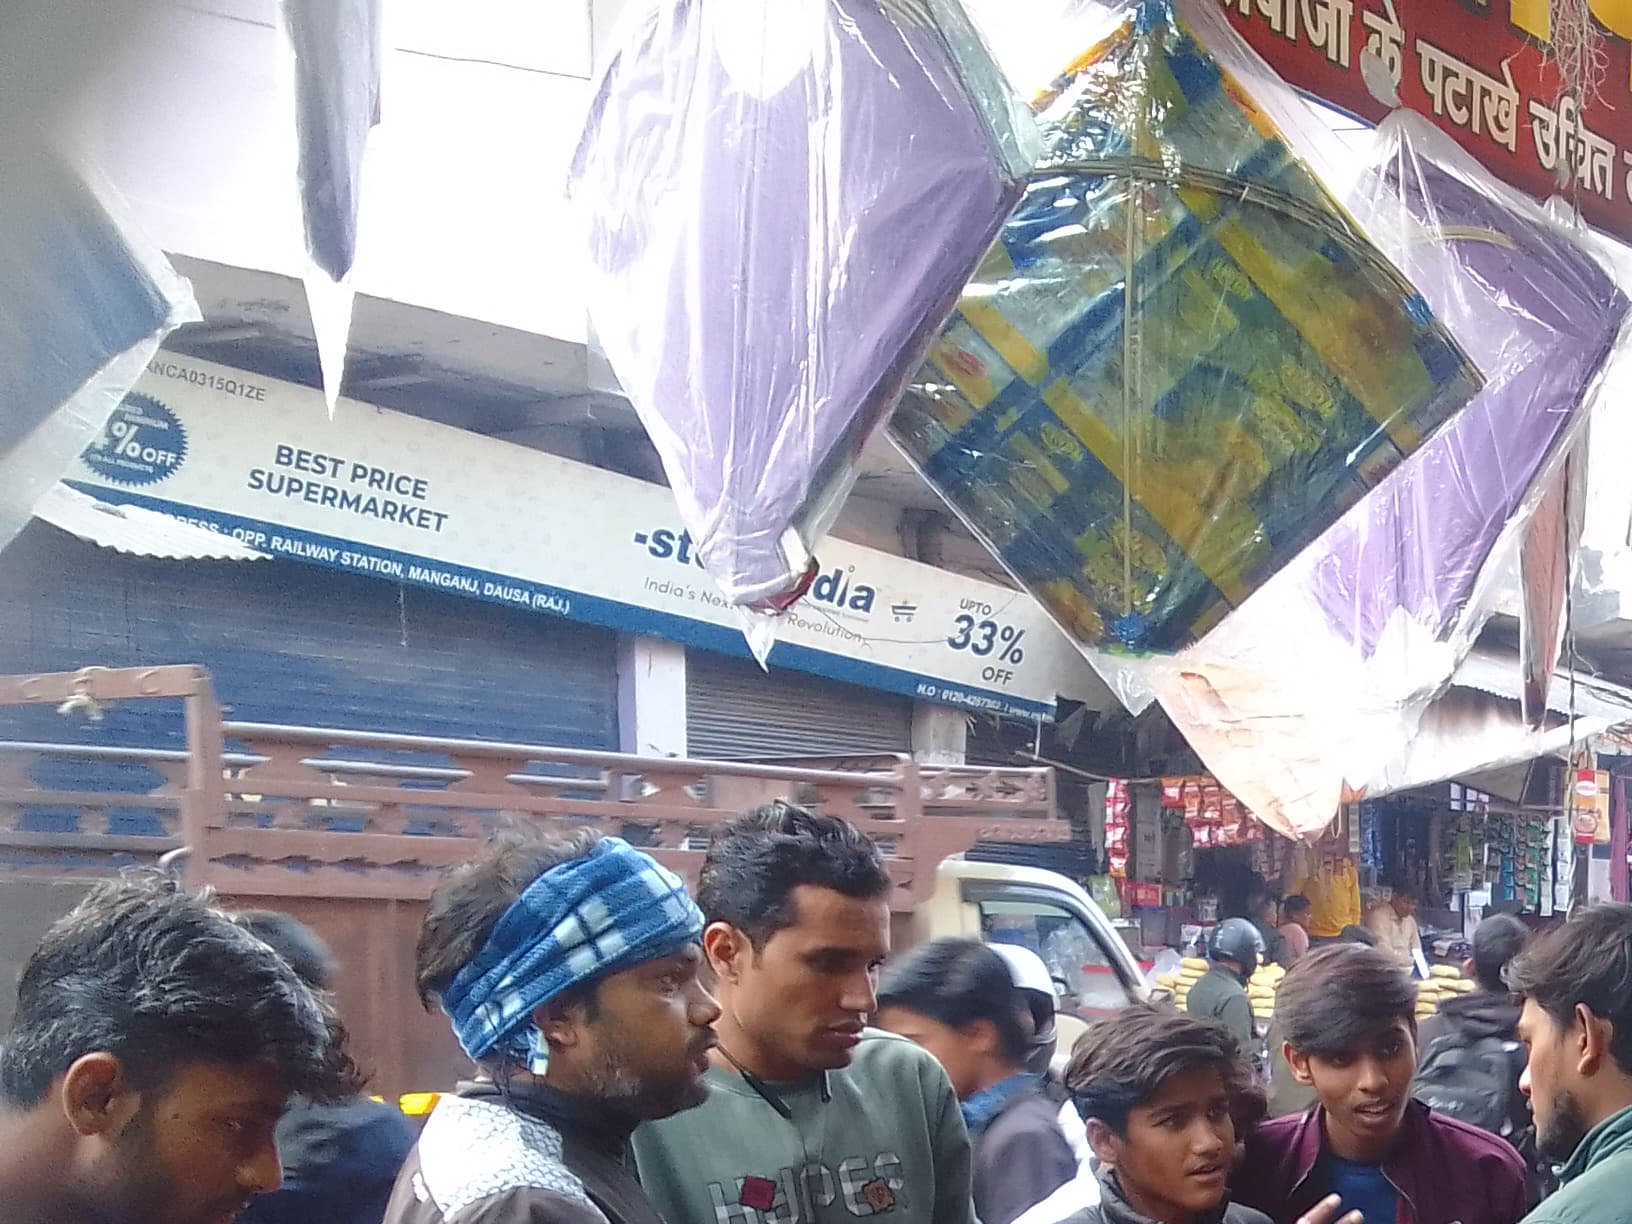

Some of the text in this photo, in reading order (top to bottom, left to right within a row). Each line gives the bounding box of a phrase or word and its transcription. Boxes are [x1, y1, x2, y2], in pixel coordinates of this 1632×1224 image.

[1416, 58, 1519, 152] पटाखे
[142, 448, 177, 466] OFF
[274, 444, 428, 500] BEST PRICE
[247, 468, 449, 534] SUPERMARKET
[232, 528, 267, 548] OPP.
[270, 536, 338, 563] RAILWAY
[340, 552, 404, 579] STATION,
[408, 566, 480, 594] MANGANJ,
[484, 582, 530, 605] DAUSA
[532, 592, 570, 616] (RAJ.)
[644, 577, 696, 600] India's
[700, 591, 736, 611] Nex
[787, 613, 862, 644] Revolution
[960, 599, 991, 615] UPTO
[947, 614, 1026, 664] 33%
[982, 667, 1013, 685] OFF
